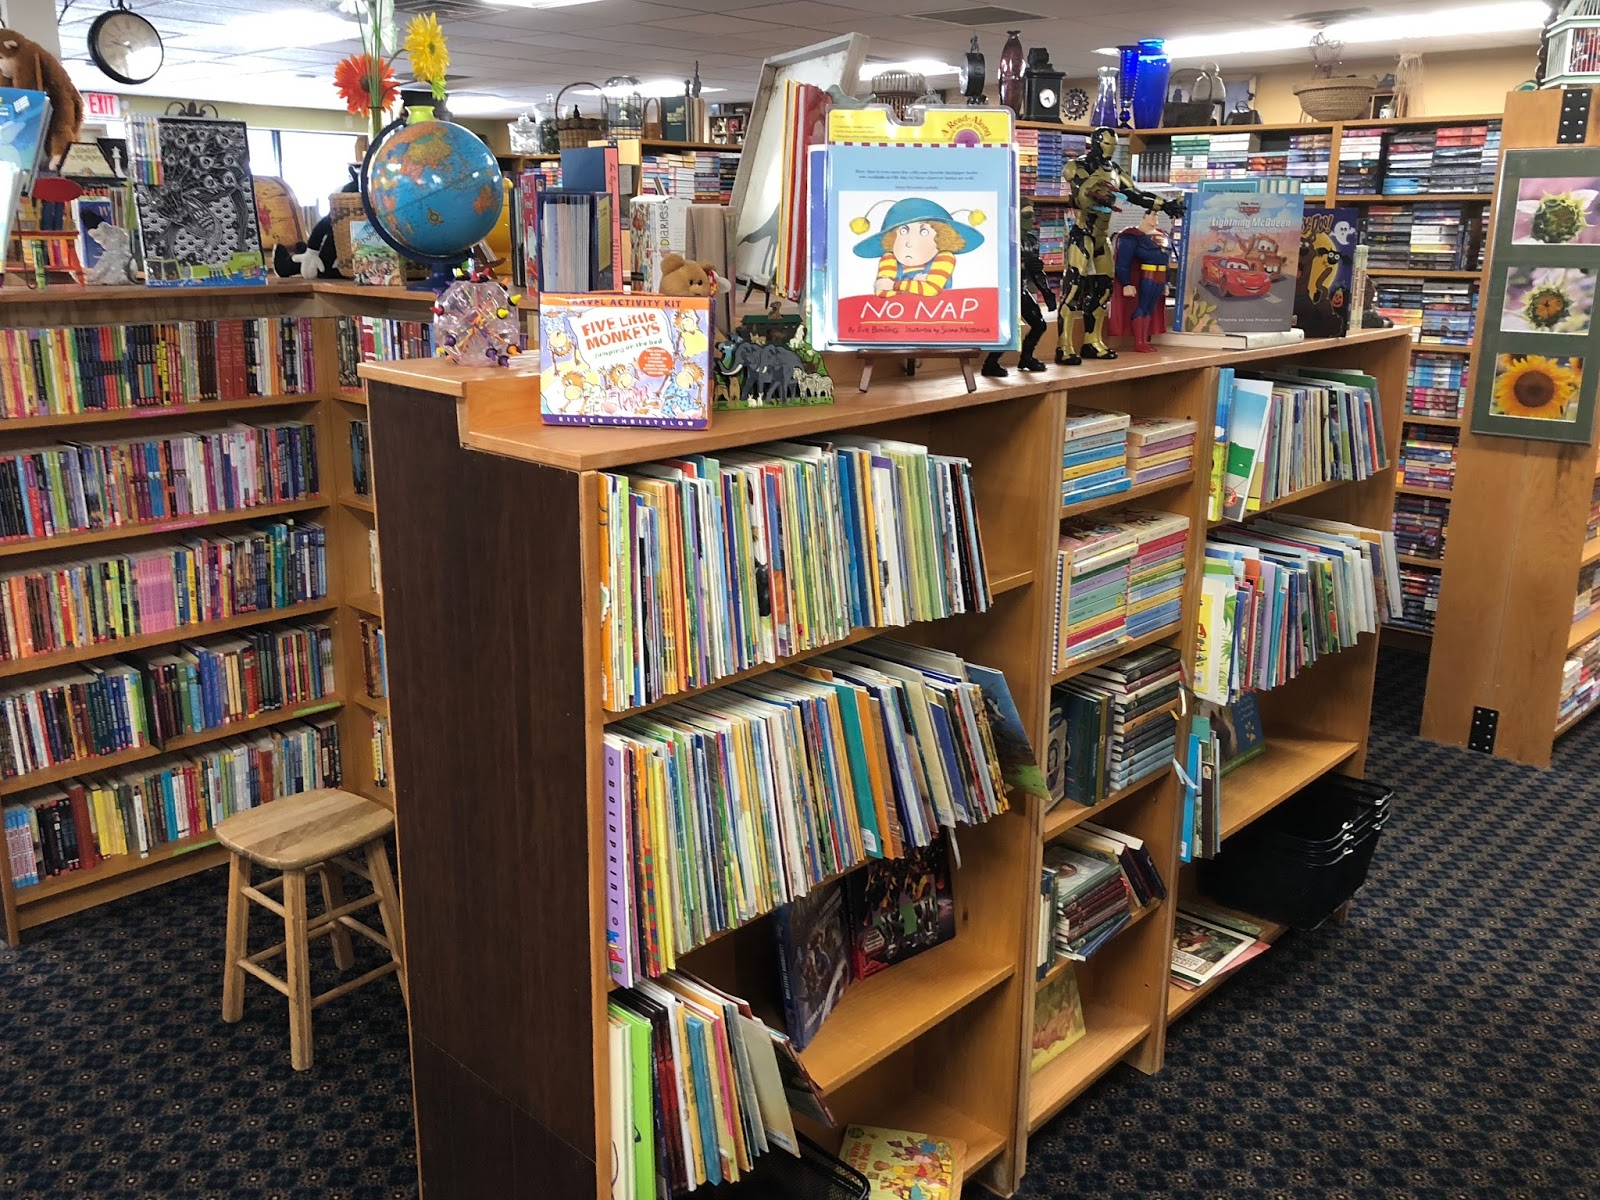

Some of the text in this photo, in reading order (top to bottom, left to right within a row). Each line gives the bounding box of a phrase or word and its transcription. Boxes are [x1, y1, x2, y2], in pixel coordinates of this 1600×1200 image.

[88, 93, 115, 115] EXIT
[946, 114, 992, 137] Read-Along
[1211, 217, 1291, 229] Lightning McQueen
[610, 298, 660, 307] ACTIVITY
[664, 300, 682, 308] KIT
[860, 298, 979, 319] NO NAP
[581, 312, 656, 337] FIVE Little
[585, 322, 661, 350] MONKEYS
[558, 416, 695, 427] EILEEN CHRISTELOW
[607, 779, 624, 974] BOLDPRINT kids
